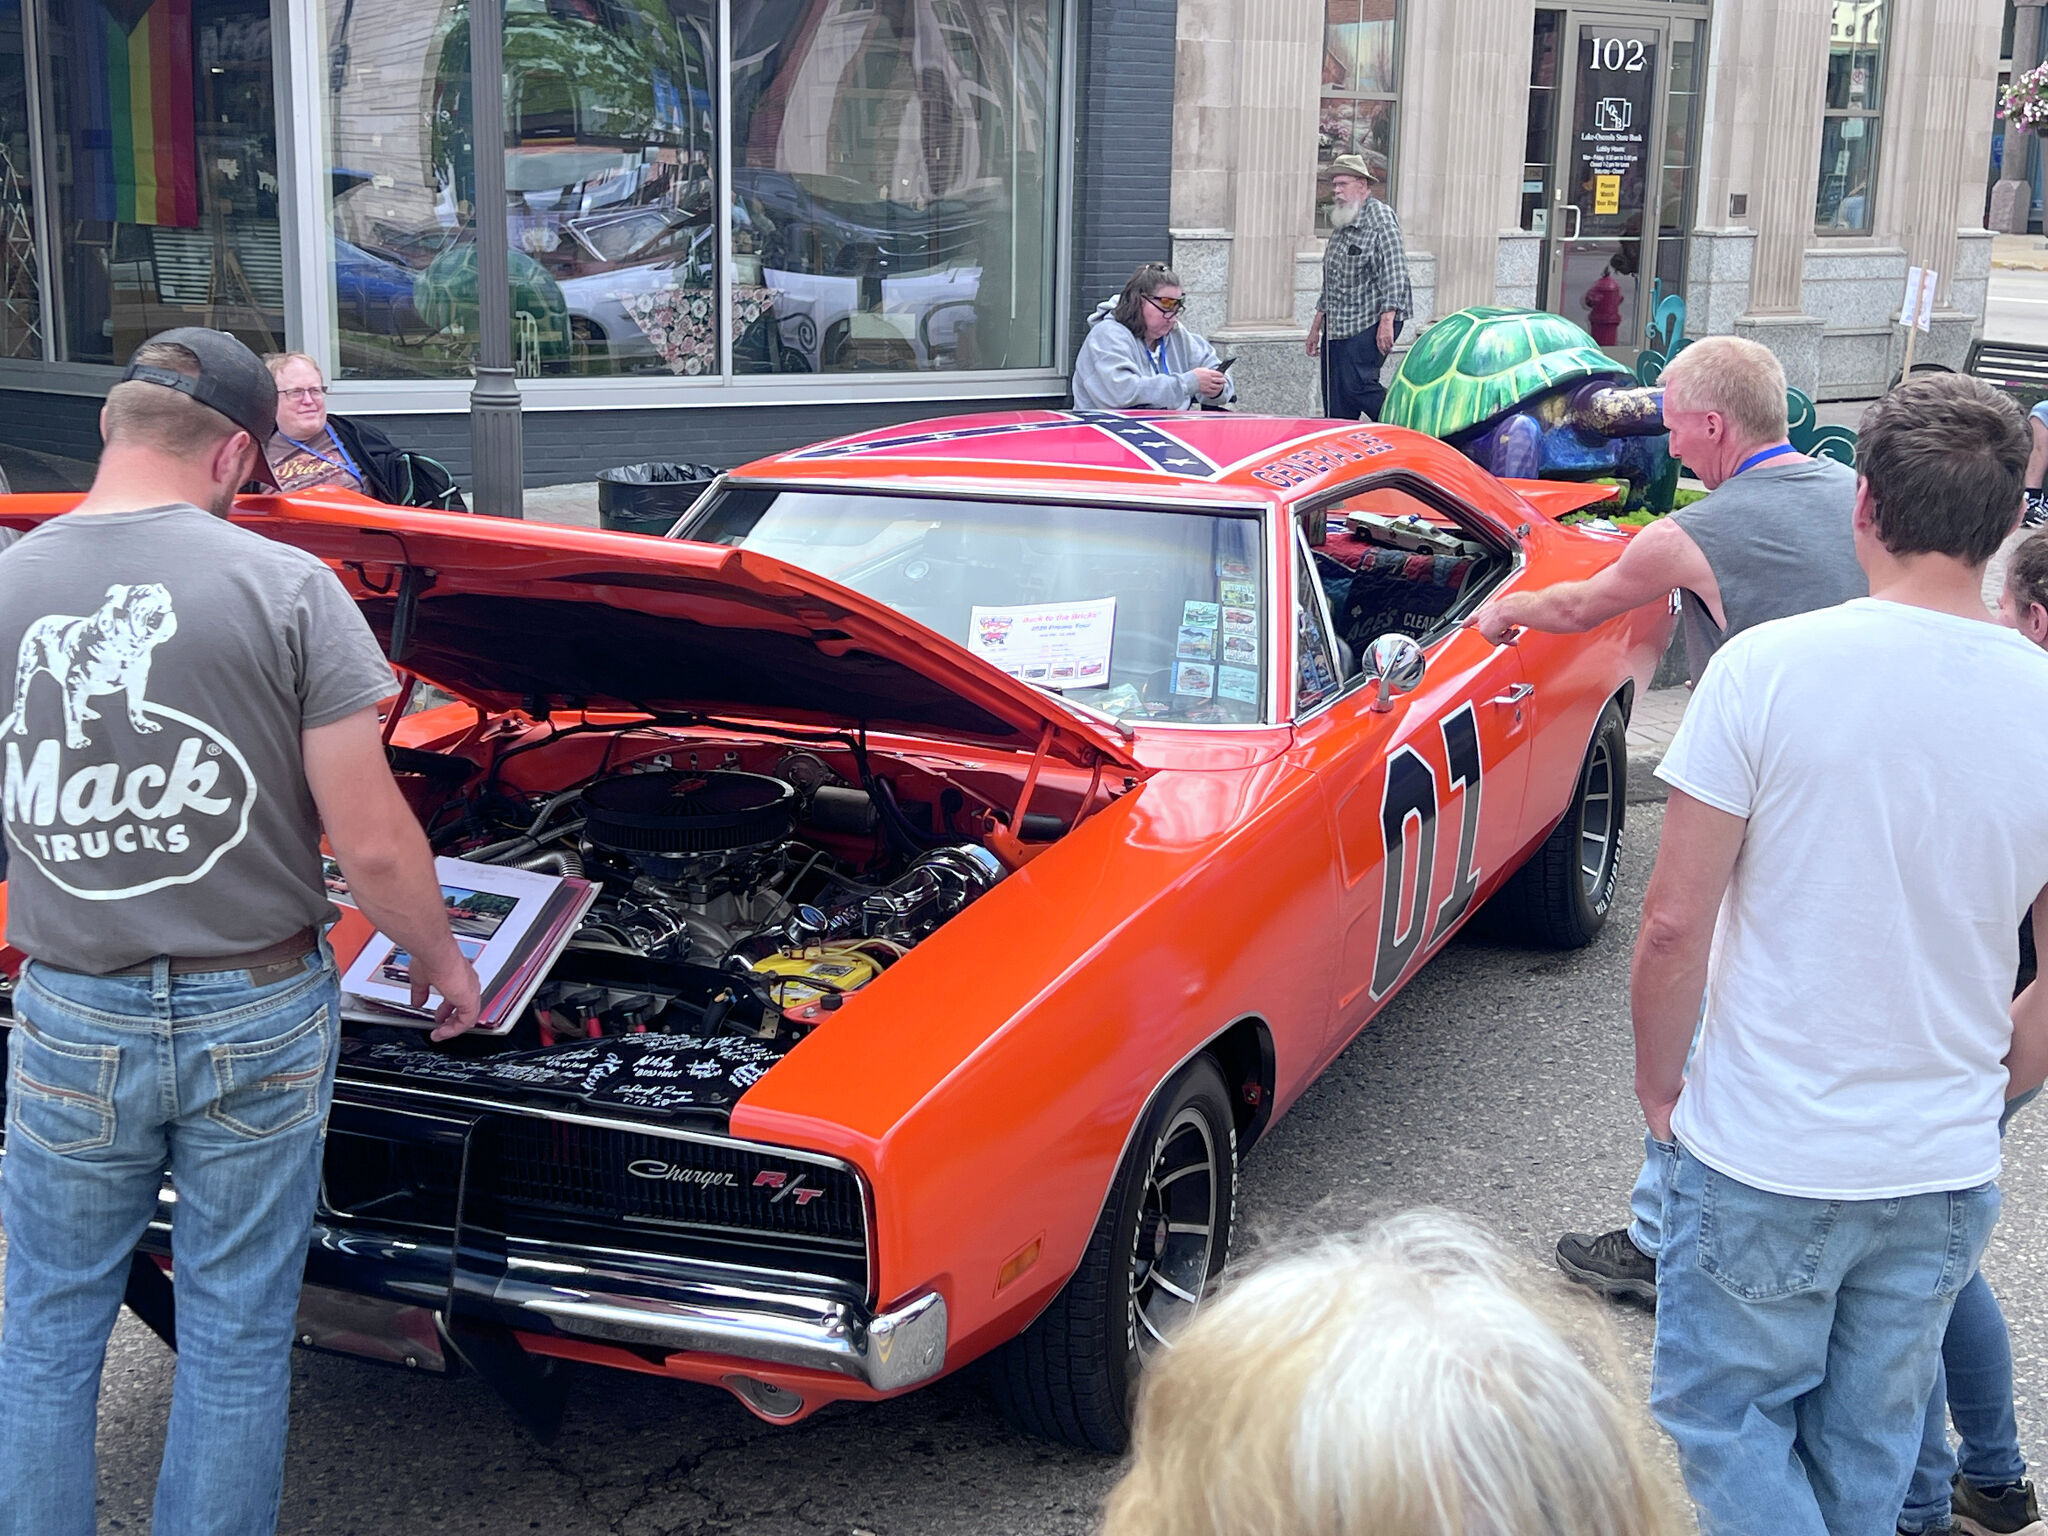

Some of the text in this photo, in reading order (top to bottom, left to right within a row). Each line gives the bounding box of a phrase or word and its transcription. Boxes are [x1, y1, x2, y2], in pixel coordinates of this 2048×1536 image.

[1590, 38, 1646, 71] 102
[4, 737, 232, 827] Mack
[33, 824, 190, 863] TRUCKS
[1368, 698, 1482, 1003] 01
[627, 1159, 827, 1206] Charger R/T
